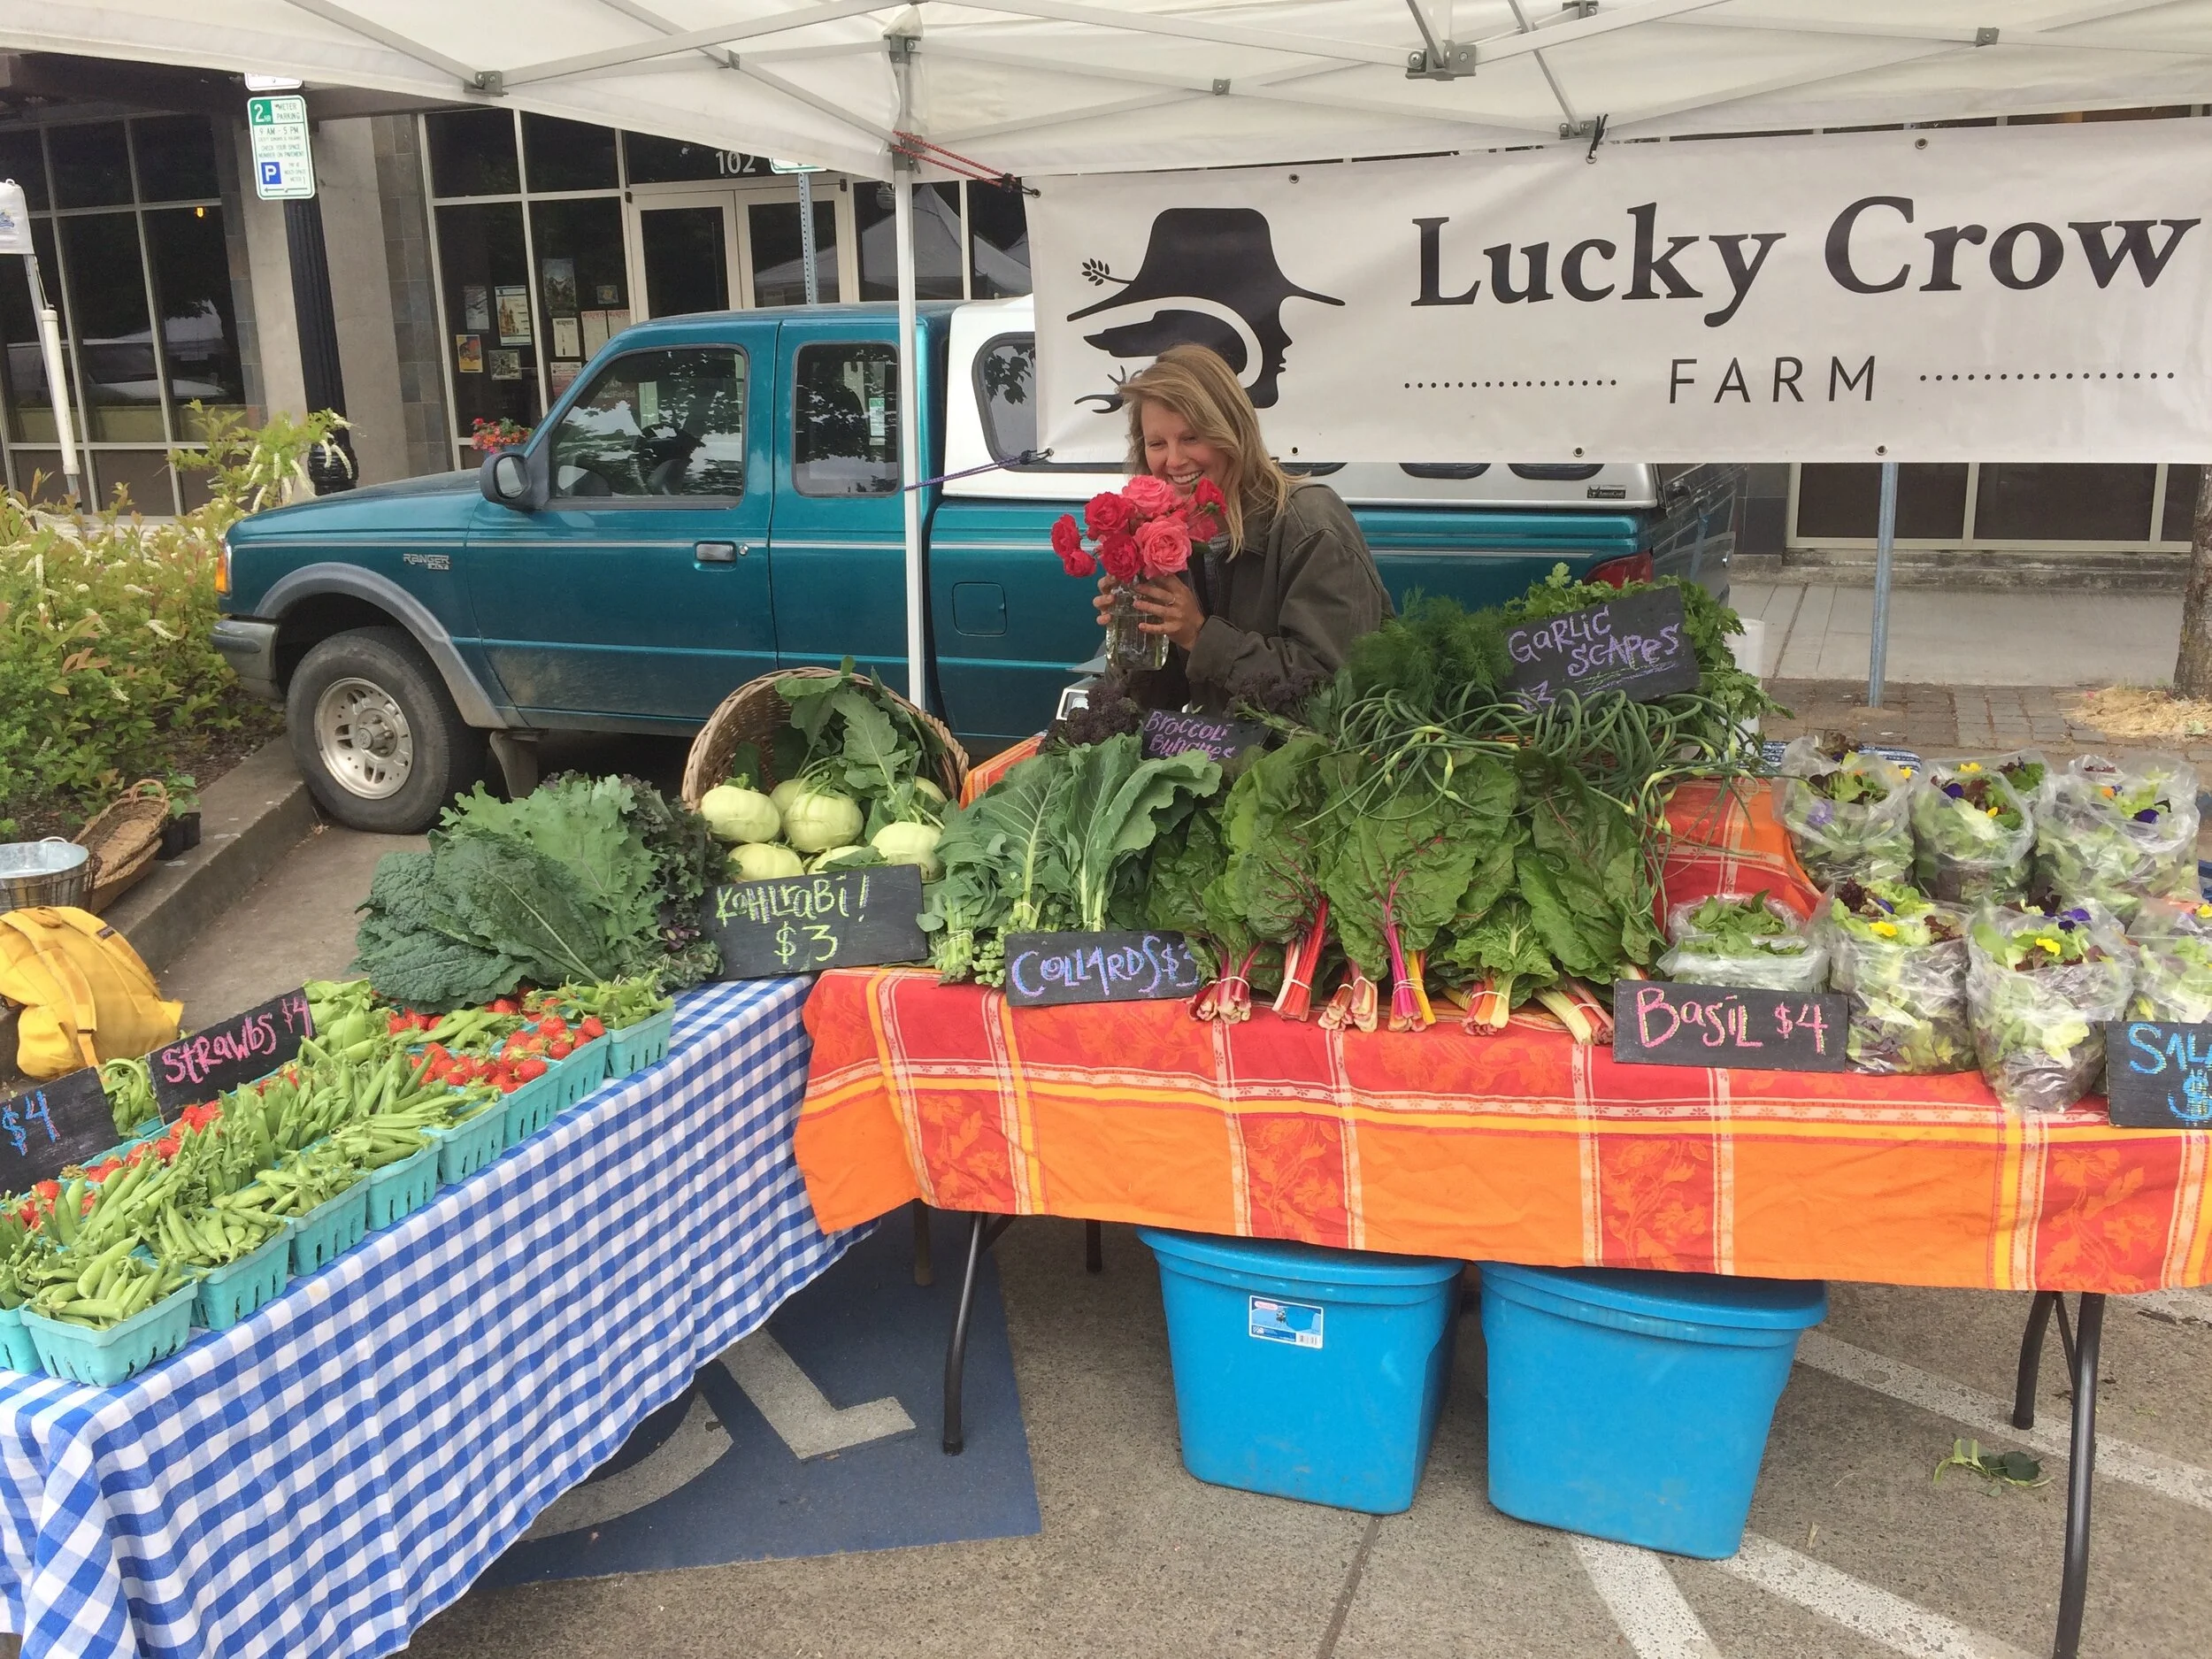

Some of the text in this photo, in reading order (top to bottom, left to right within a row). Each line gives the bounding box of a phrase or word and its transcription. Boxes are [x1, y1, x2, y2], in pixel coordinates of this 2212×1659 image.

[276, 112, 301, 121] PARKING
[715, 150, 757, 174] 102
[1411, 196, 2201, 327] Lucky Crow
[1670, 356, 1876, 403] FARM
[403, 553, 450, 565] RANGER
[773, 920, 839, 965] $3
[281, 996, 313, 1038] $4
[1774, 1002, 1829, 1056] $4
[2128, 1022, 2212, 1073] SAL
[1, 1089, 61, 1156] $4
